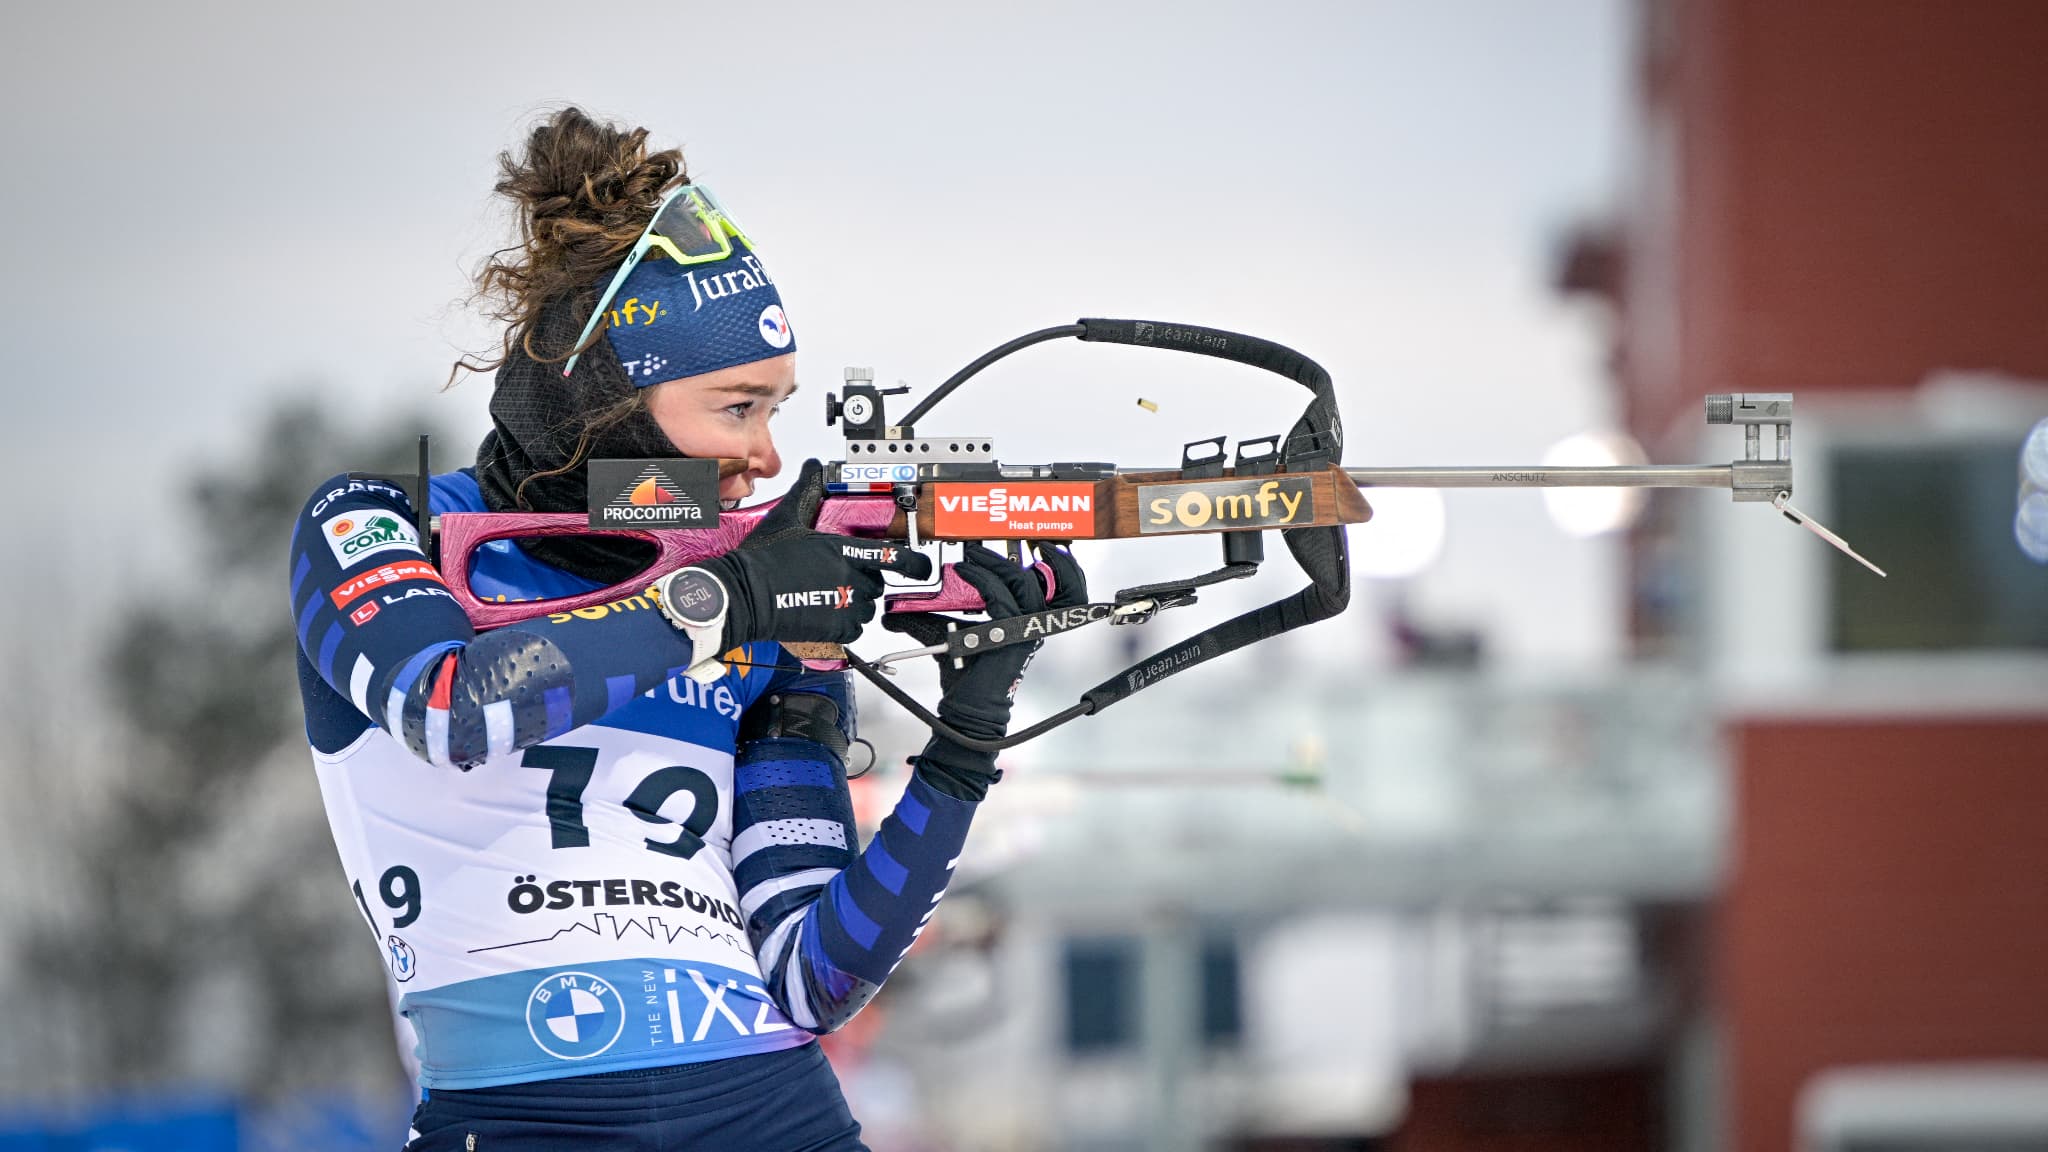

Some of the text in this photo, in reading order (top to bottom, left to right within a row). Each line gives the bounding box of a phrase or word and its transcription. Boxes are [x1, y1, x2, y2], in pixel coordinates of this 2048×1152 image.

[681, 255, 773, 312] JuraF
[311, 479, 403, 518] CRAFT
[938, 488, 1091, 523] VIESSMANN
[1009, 520, 1074, 533] Heat pumps
[1150, 480, 1303, 528] somfy
[521, 745, 719, 861] 19
[352, 864, 422, 941] 19
[507, 874, 745, 931] ÖSTERSUND
[641, 969, 664, 1047] THE NEW
